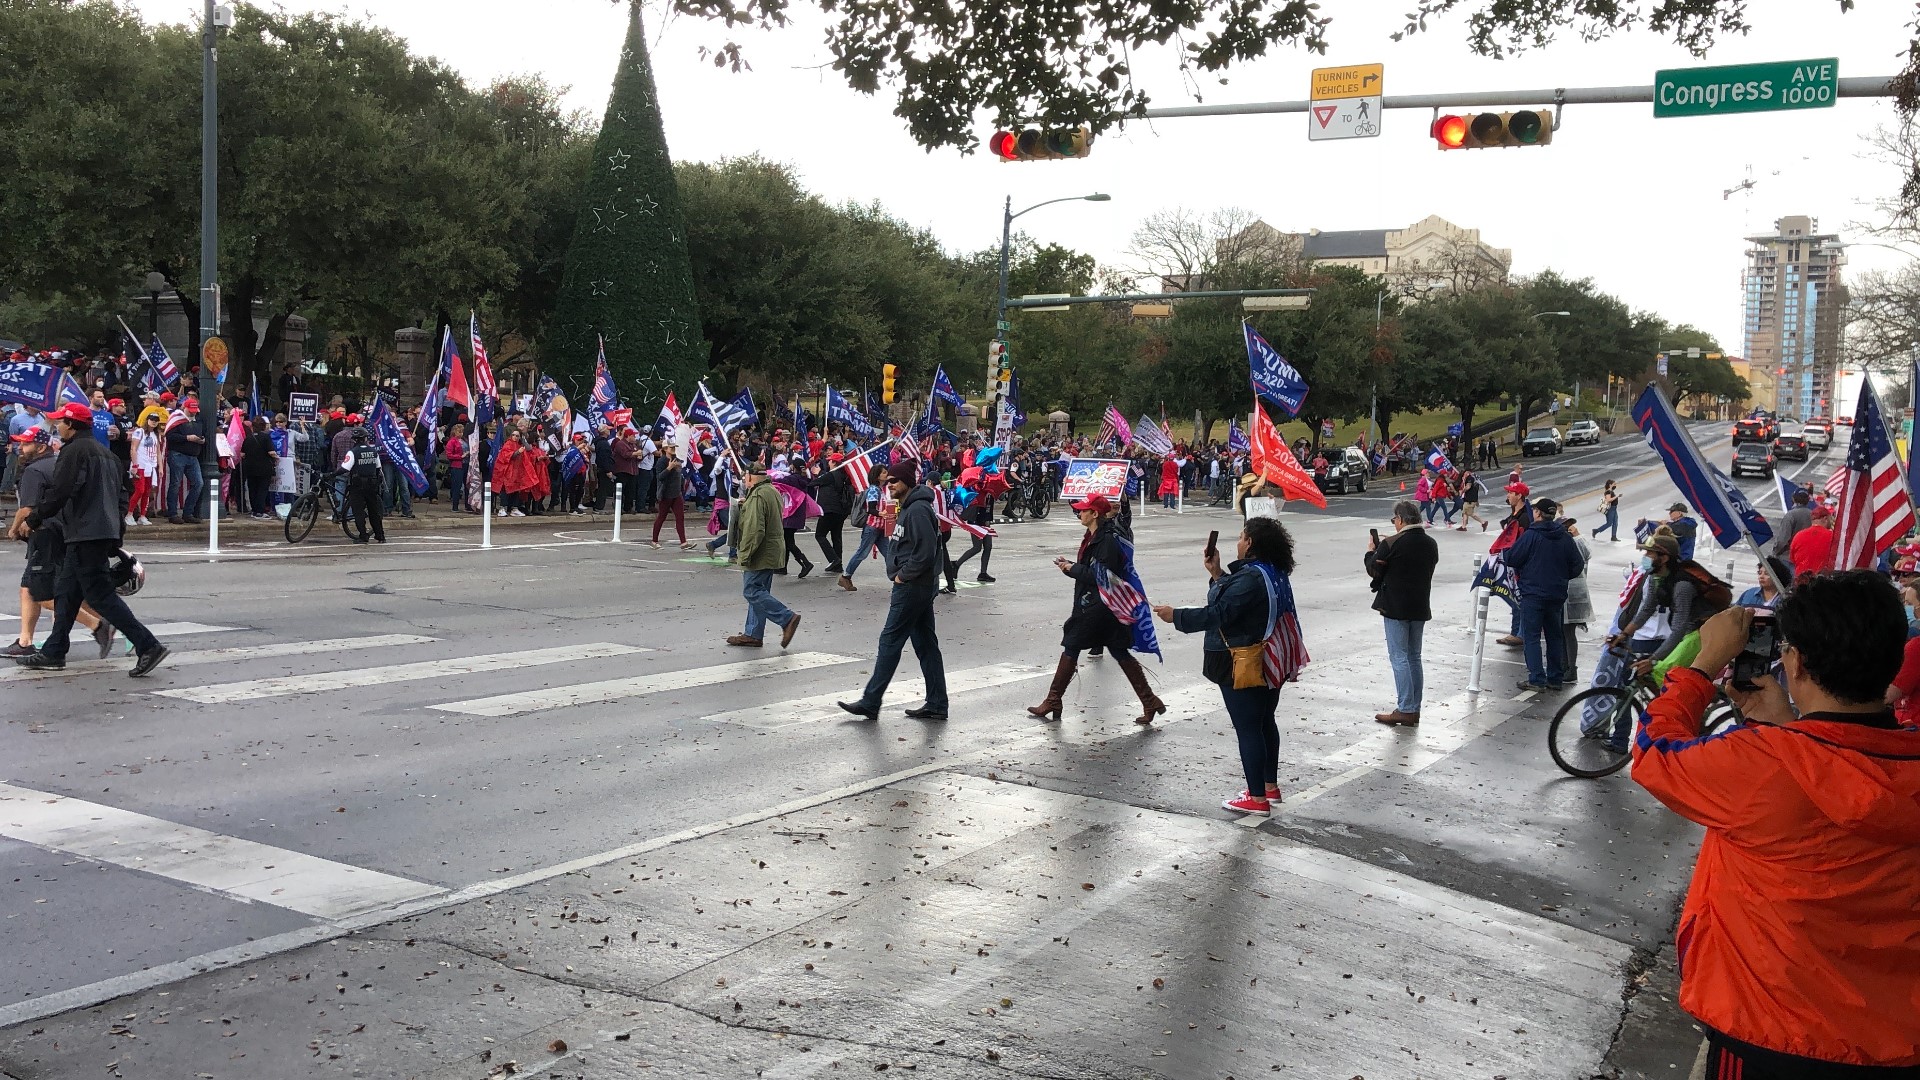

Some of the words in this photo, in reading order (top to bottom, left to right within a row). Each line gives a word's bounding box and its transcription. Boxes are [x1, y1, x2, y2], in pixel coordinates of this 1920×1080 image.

[1317, 71, 1359, 82] TURNING
[1791, 64, 1832, 83] AVE
[1315, 84, 1359, 95] VEHICLES
[1660, 80, 1774, 108] Congress
[1781, 85, 1831, 104] 1000
[1342, 114, 1353, 123] TO
[293, 398, 315, 407] TRUMP
[831, 405, 874, 435] TRUMP
[996, 427, 1011, 441] STOP
[360, 451, 375, 459] STATE
[1260, 459, 1285, 476] AMERICA
[1284, 472, 1303, 485] GREAT
